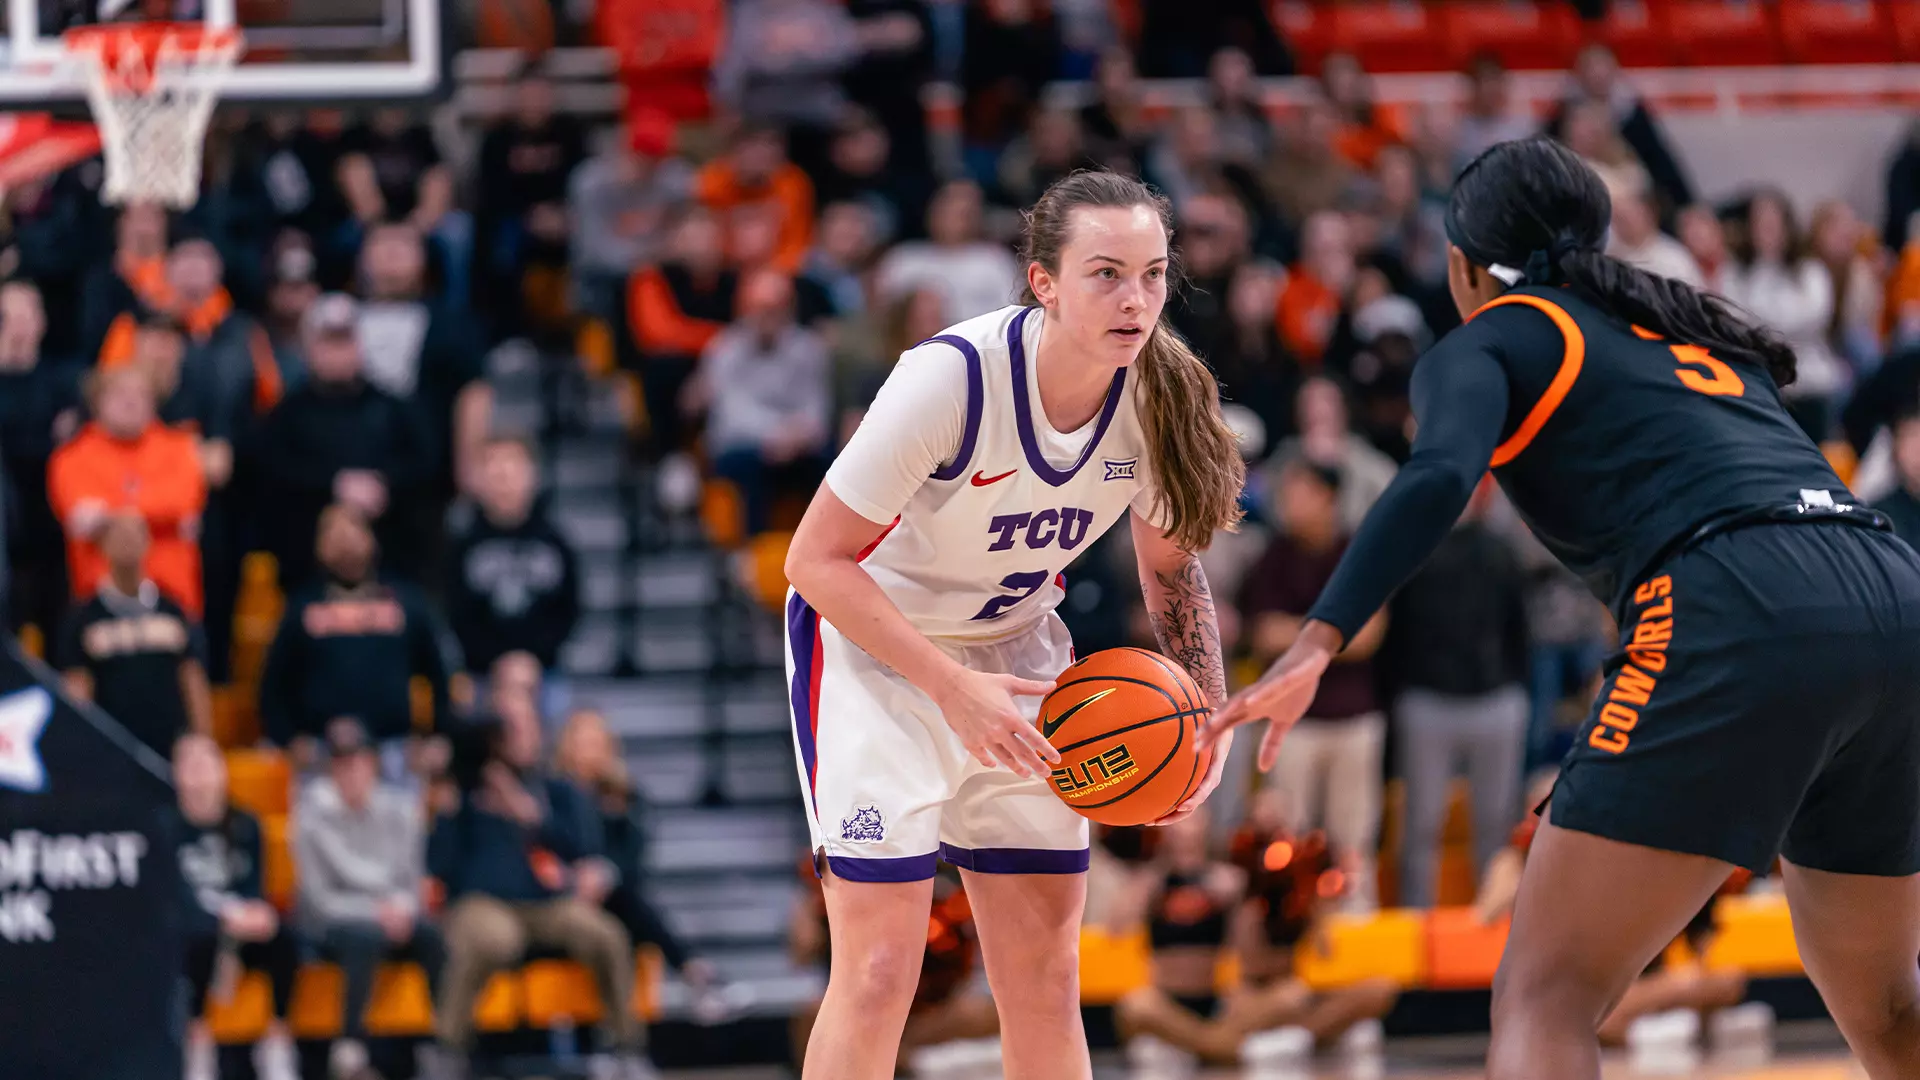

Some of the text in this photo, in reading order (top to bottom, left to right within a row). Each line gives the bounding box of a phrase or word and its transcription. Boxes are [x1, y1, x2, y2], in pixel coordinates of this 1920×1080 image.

[988, 507, 1094, 552] TCU
[969, 569, 1049, 621] 2
[1051, 743, 1136, 793] ELITE
